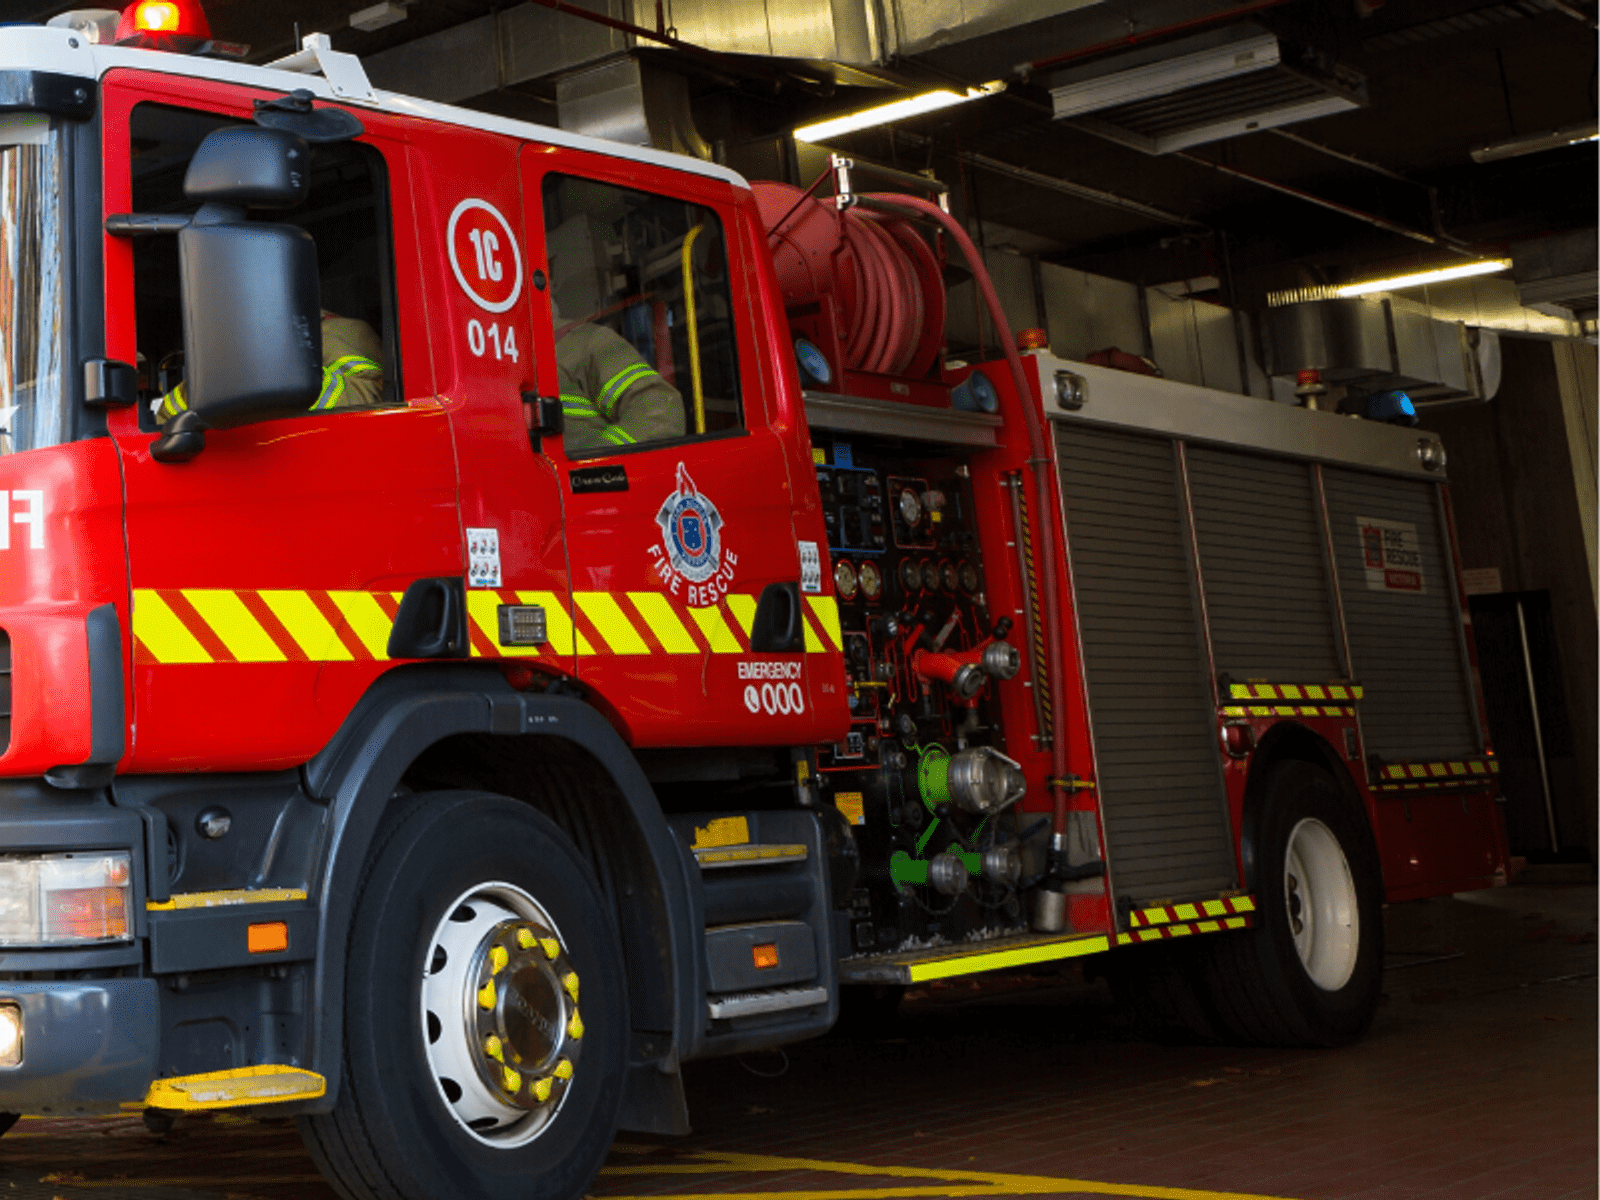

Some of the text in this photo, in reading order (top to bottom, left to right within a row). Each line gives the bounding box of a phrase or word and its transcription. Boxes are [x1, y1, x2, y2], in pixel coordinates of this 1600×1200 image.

[469, 228, 503, 281] 1C
[468, 319, 519, 363] 014
[647, 544, 738, 605] FIRE RESCUE
[737, 661, 801, 679] EMERGENCY
[761, 682, 805, 715] 000
